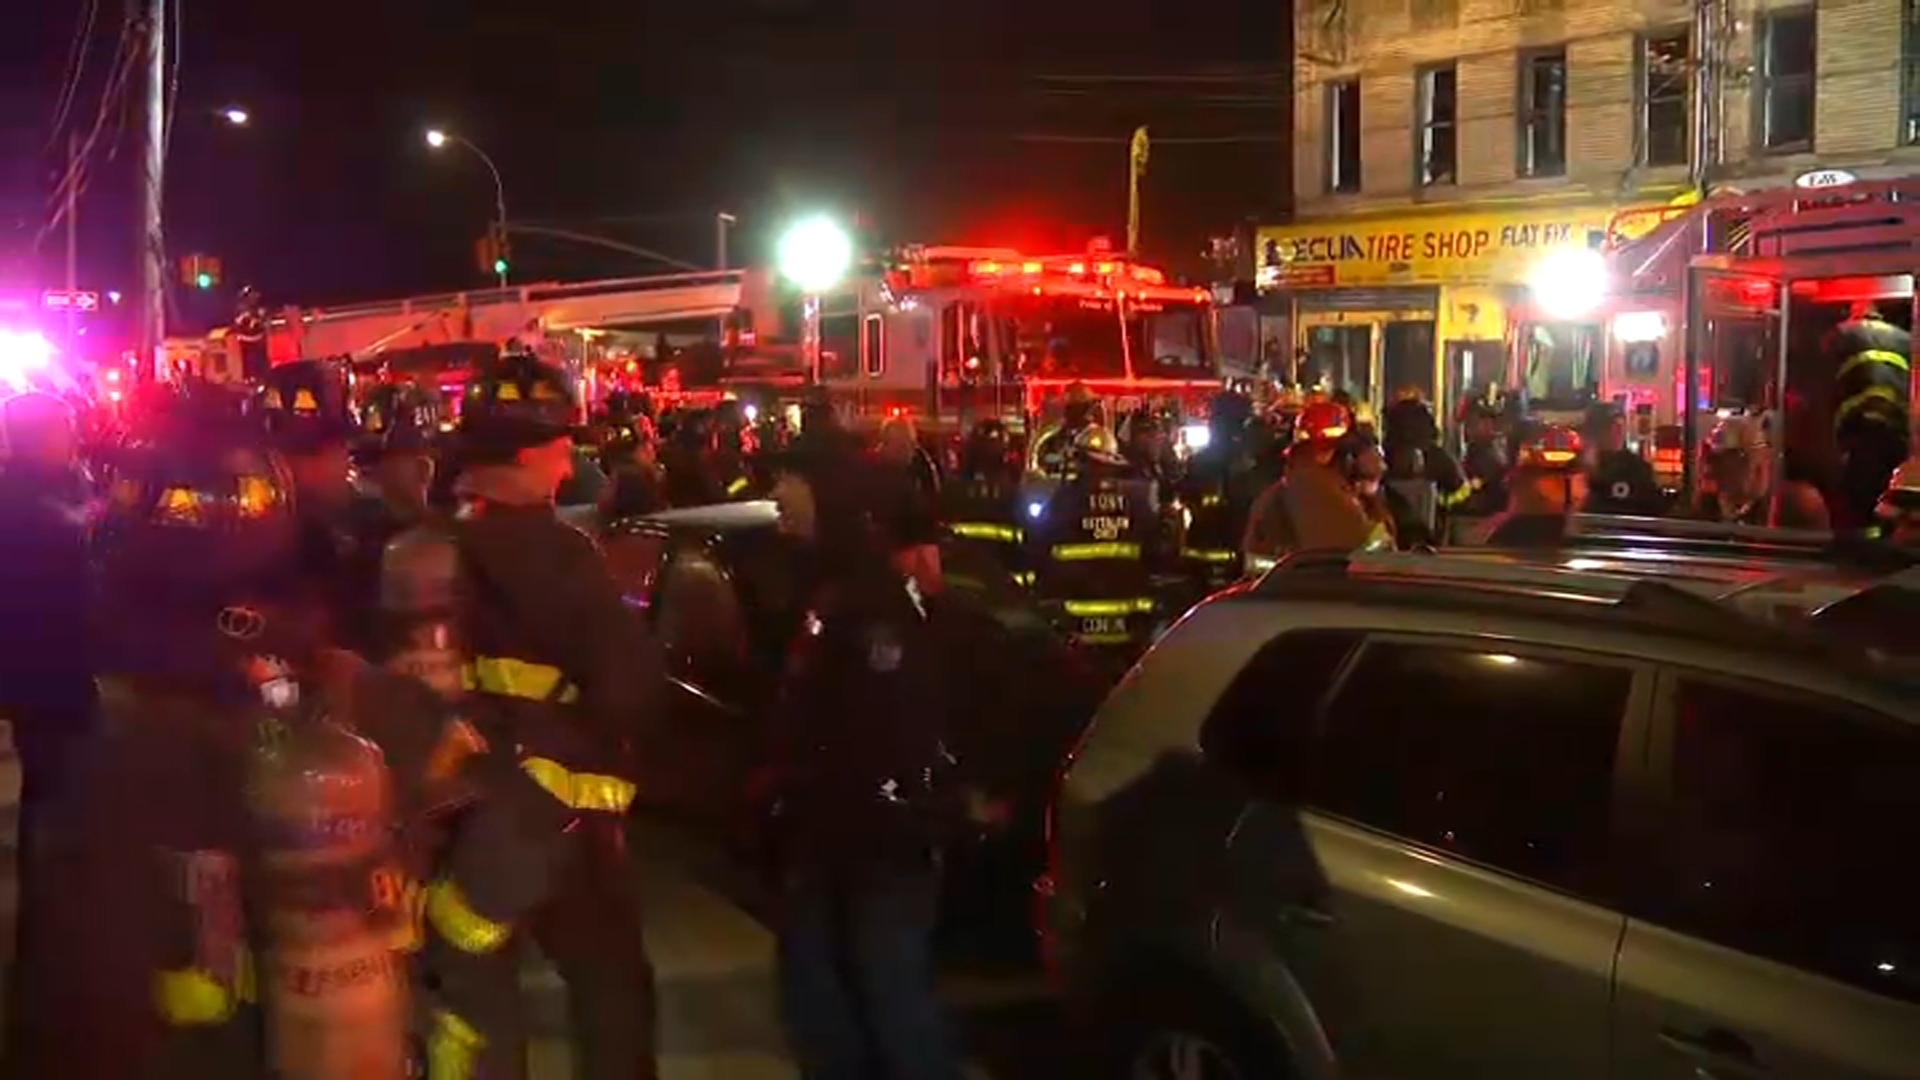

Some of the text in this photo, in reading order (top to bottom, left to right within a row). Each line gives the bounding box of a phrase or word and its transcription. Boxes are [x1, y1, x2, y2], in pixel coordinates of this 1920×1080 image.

[1366, 233, 1415, 261] TIRE
[1422, 230, 1489, 259] SHOP
[1500, 223, 1571, 248] FLAT FIX
